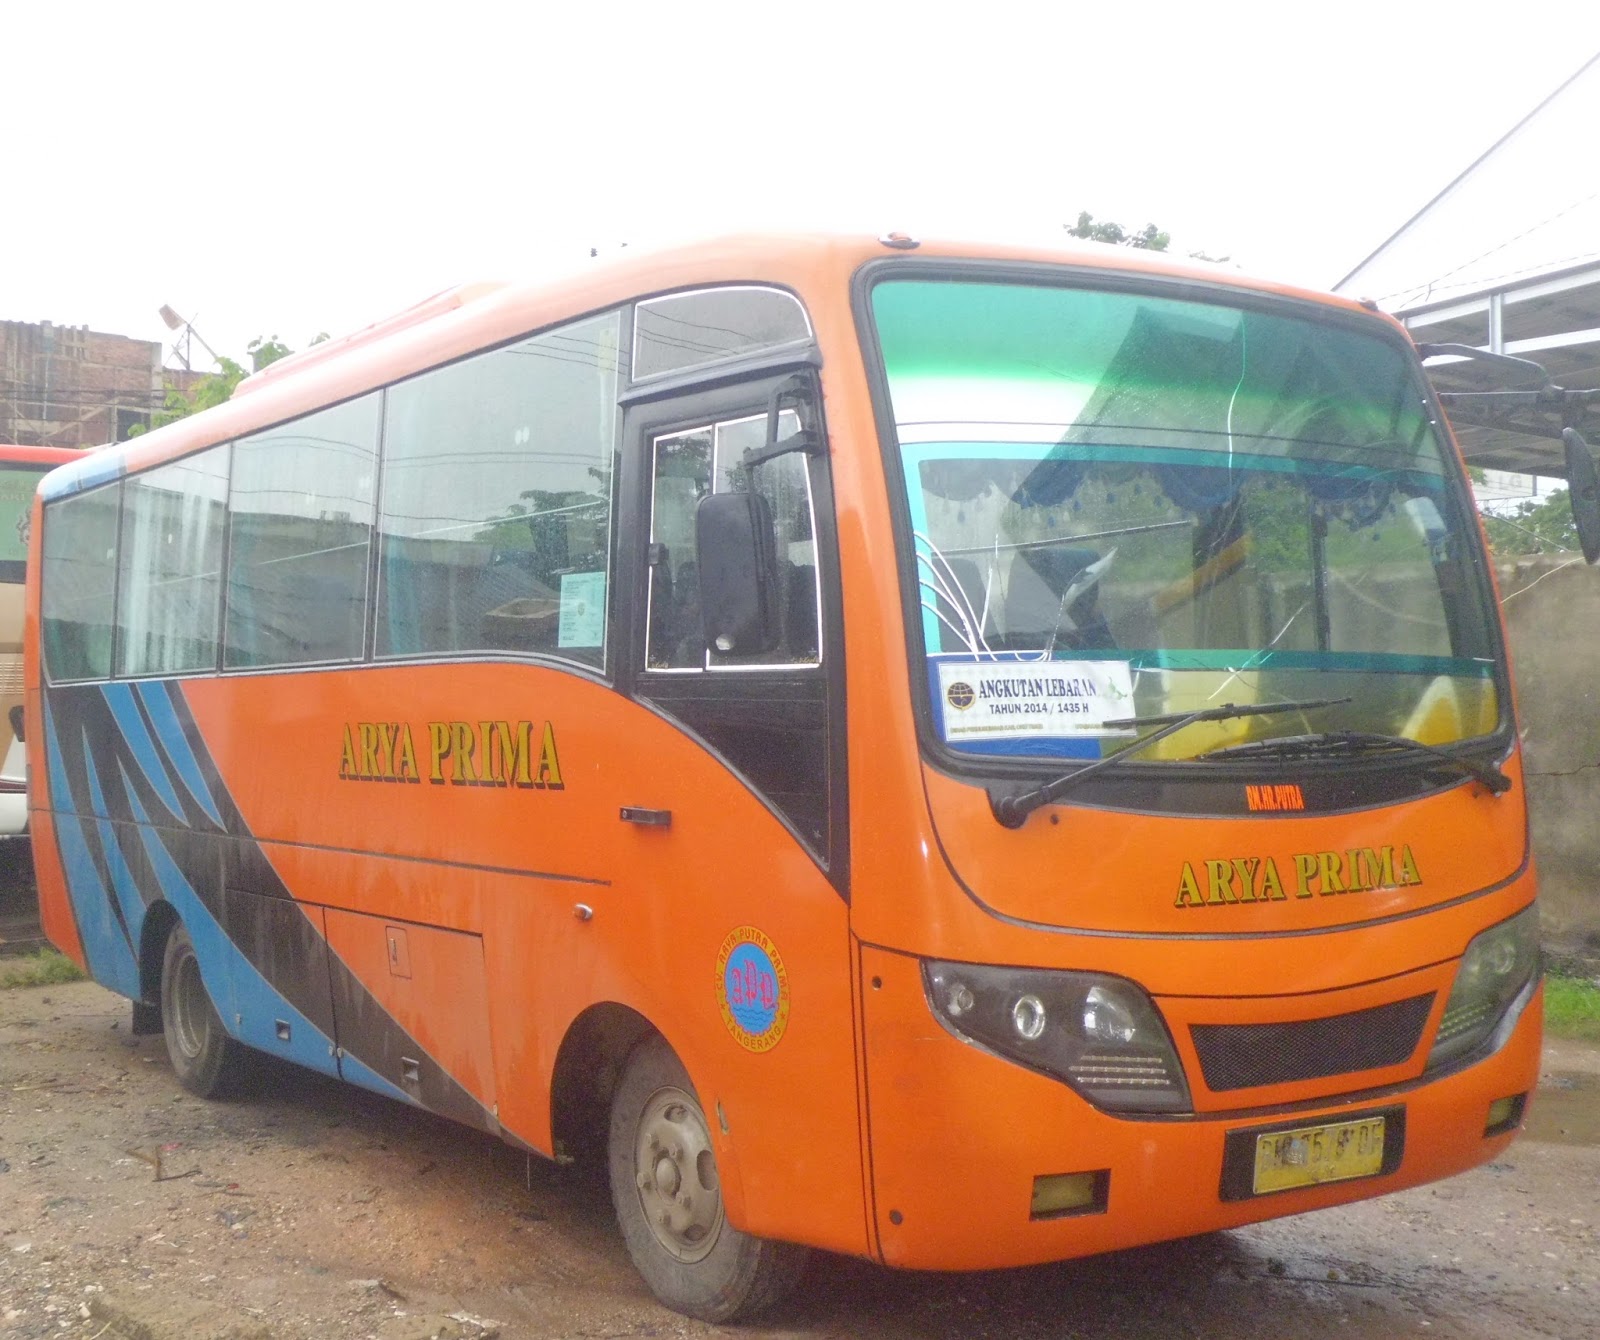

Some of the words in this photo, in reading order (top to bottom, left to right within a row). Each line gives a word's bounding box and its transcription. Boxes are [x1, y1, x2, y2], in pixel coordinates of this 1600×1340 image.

[979, 679, 1044, 698] ANGKUTAN
[1045, 678, 1097, 697] LEBARAN
[989, 703, 1022, 715] TAHUN
[1024, 703, 1048, 713] 2014
[1058, 702, 1080, 713] 1435
[1082, 702, 1090, 713] H
[338, 721, 421, 784] ARYA
[428, 720, 565, 791] PRIMA
[1174, 856, 1287, 909] ARYA
[1292, 843, 1423, 899] PRIMA
[739, 928, 768, 948] PUTRA
[770, 949, 788, 1000] PRIMA
[726, 1018, 782, 1049] TANGERANG
